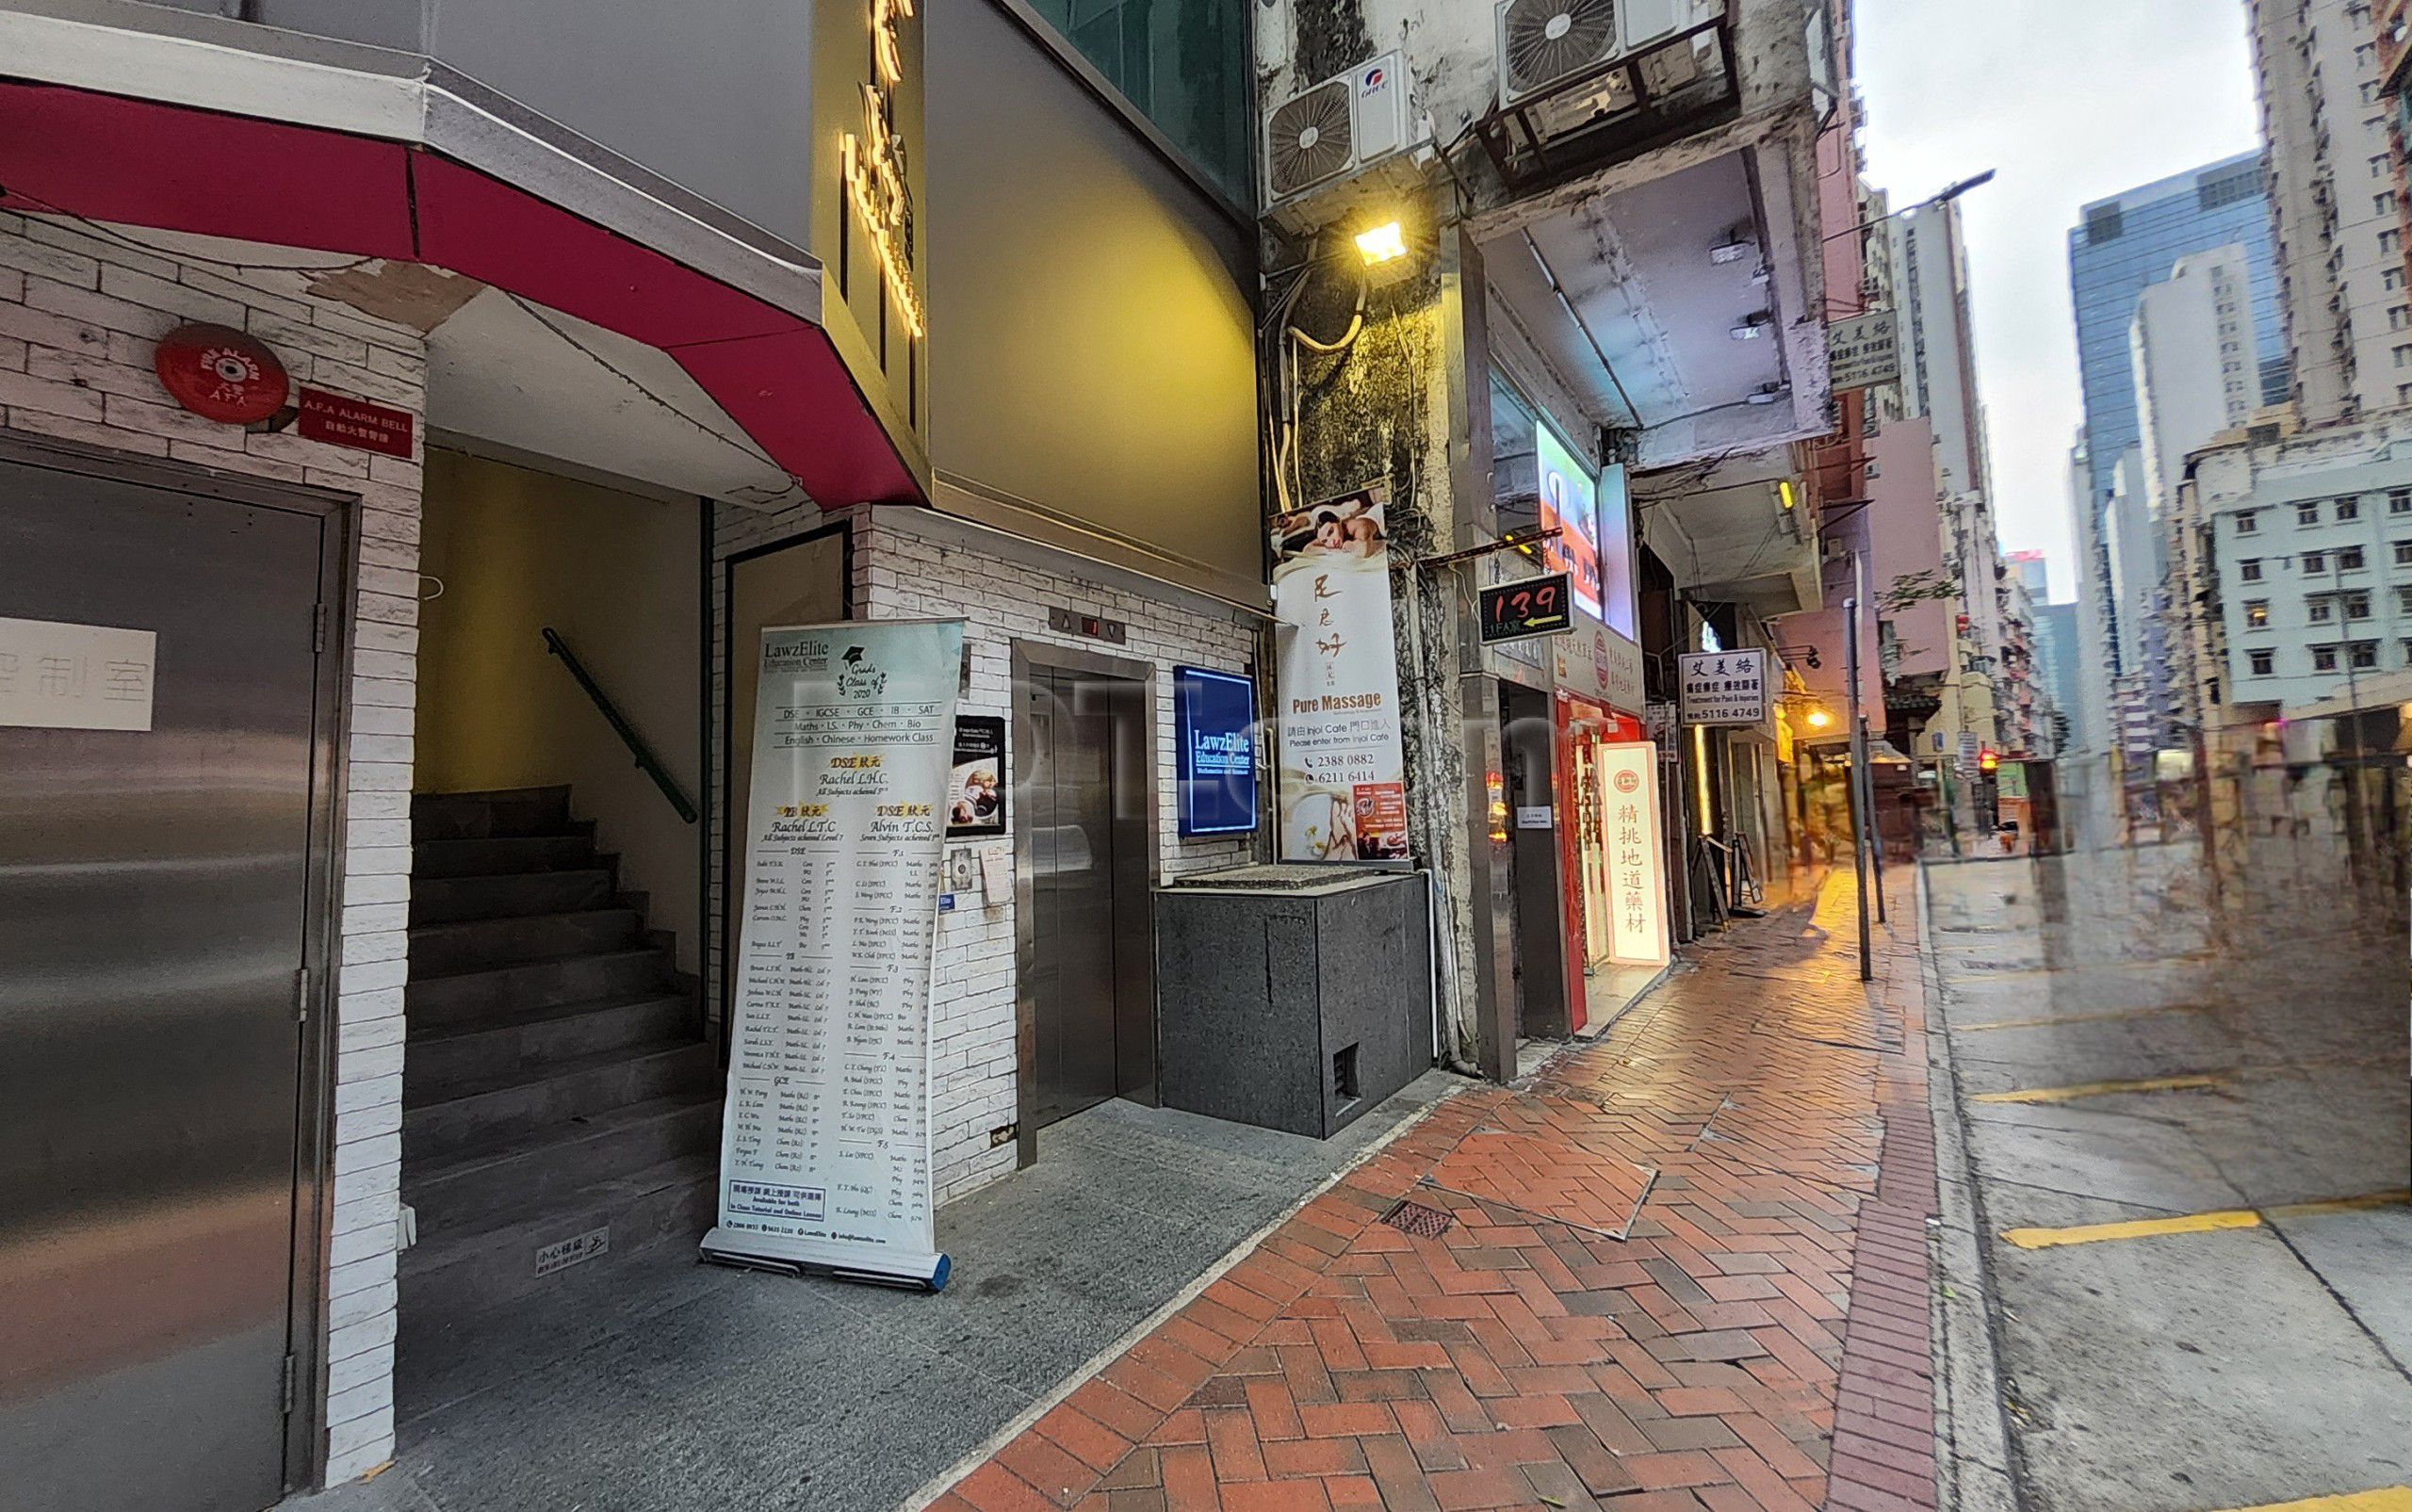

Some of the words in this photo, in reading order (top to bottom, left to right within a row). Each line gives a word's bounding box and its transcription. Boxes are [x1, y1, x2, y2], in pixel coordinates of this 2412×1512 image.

[339, 408, 378, 424] ALARM
[382, 417, 408, 432] BELL
[1495, 586, 1556, 622] 139
[765, 641, 829, 658] LawzElite
[845, 676, 867, 687] Class
[853, 689, 871, 699] 2020
[1293, 698, 1318, 714] Pure
[1322, 692, 1381, 711] Massage
[784, 709, 799, 720] DSE
[816, 707, 839, 718] IGCSE
[856, 707, 873, 716] GCE
[891, 706, 899, 715] IB
[918, 705, 934, 714] SAT
[1702, 709, 1729, 719] 5116
[1732, 707, 1760, 717] 4749
[848, 720, 864, 731] Phy
[872, 719, 896, 729] Chem
[907, 719, 921, 728] Bio
[1325, 723, 1347, 734] Cafe
[785, 734, 814, 745] English
[822, 734, 855, 744] Chinese
[864, 732, 910, 743] Homework
[912, 732, 934, 742] Class
[1194, 729, 1249, 753] LawzElite
[1290, 739, 1311, 747] Please
[1312, 738, 1330, 746] enter
[1333, 736, 1350, 744] from
[1370, 732, 1389, 742] Cafe
[831, 756, 857, 768] DSE
[1196, 751, 1229, 764] Education
[1230, 752, 1249, 765] Center
[1318, 756, 1344, 767] 2388
[1347, 754, 1374, 765] 0882
[820, 771, 855, 785] Rachel
[1319, 772, 1344, 783] 6211
[1348, 771, 1375, 782] 6414
[877, 805, 904, 817] DSE
[772, 819, 806, 833] Rachel
[871, 819, 900, 833] Alvin
[1618, 804, 1647, 934] 精挑地道藥材
